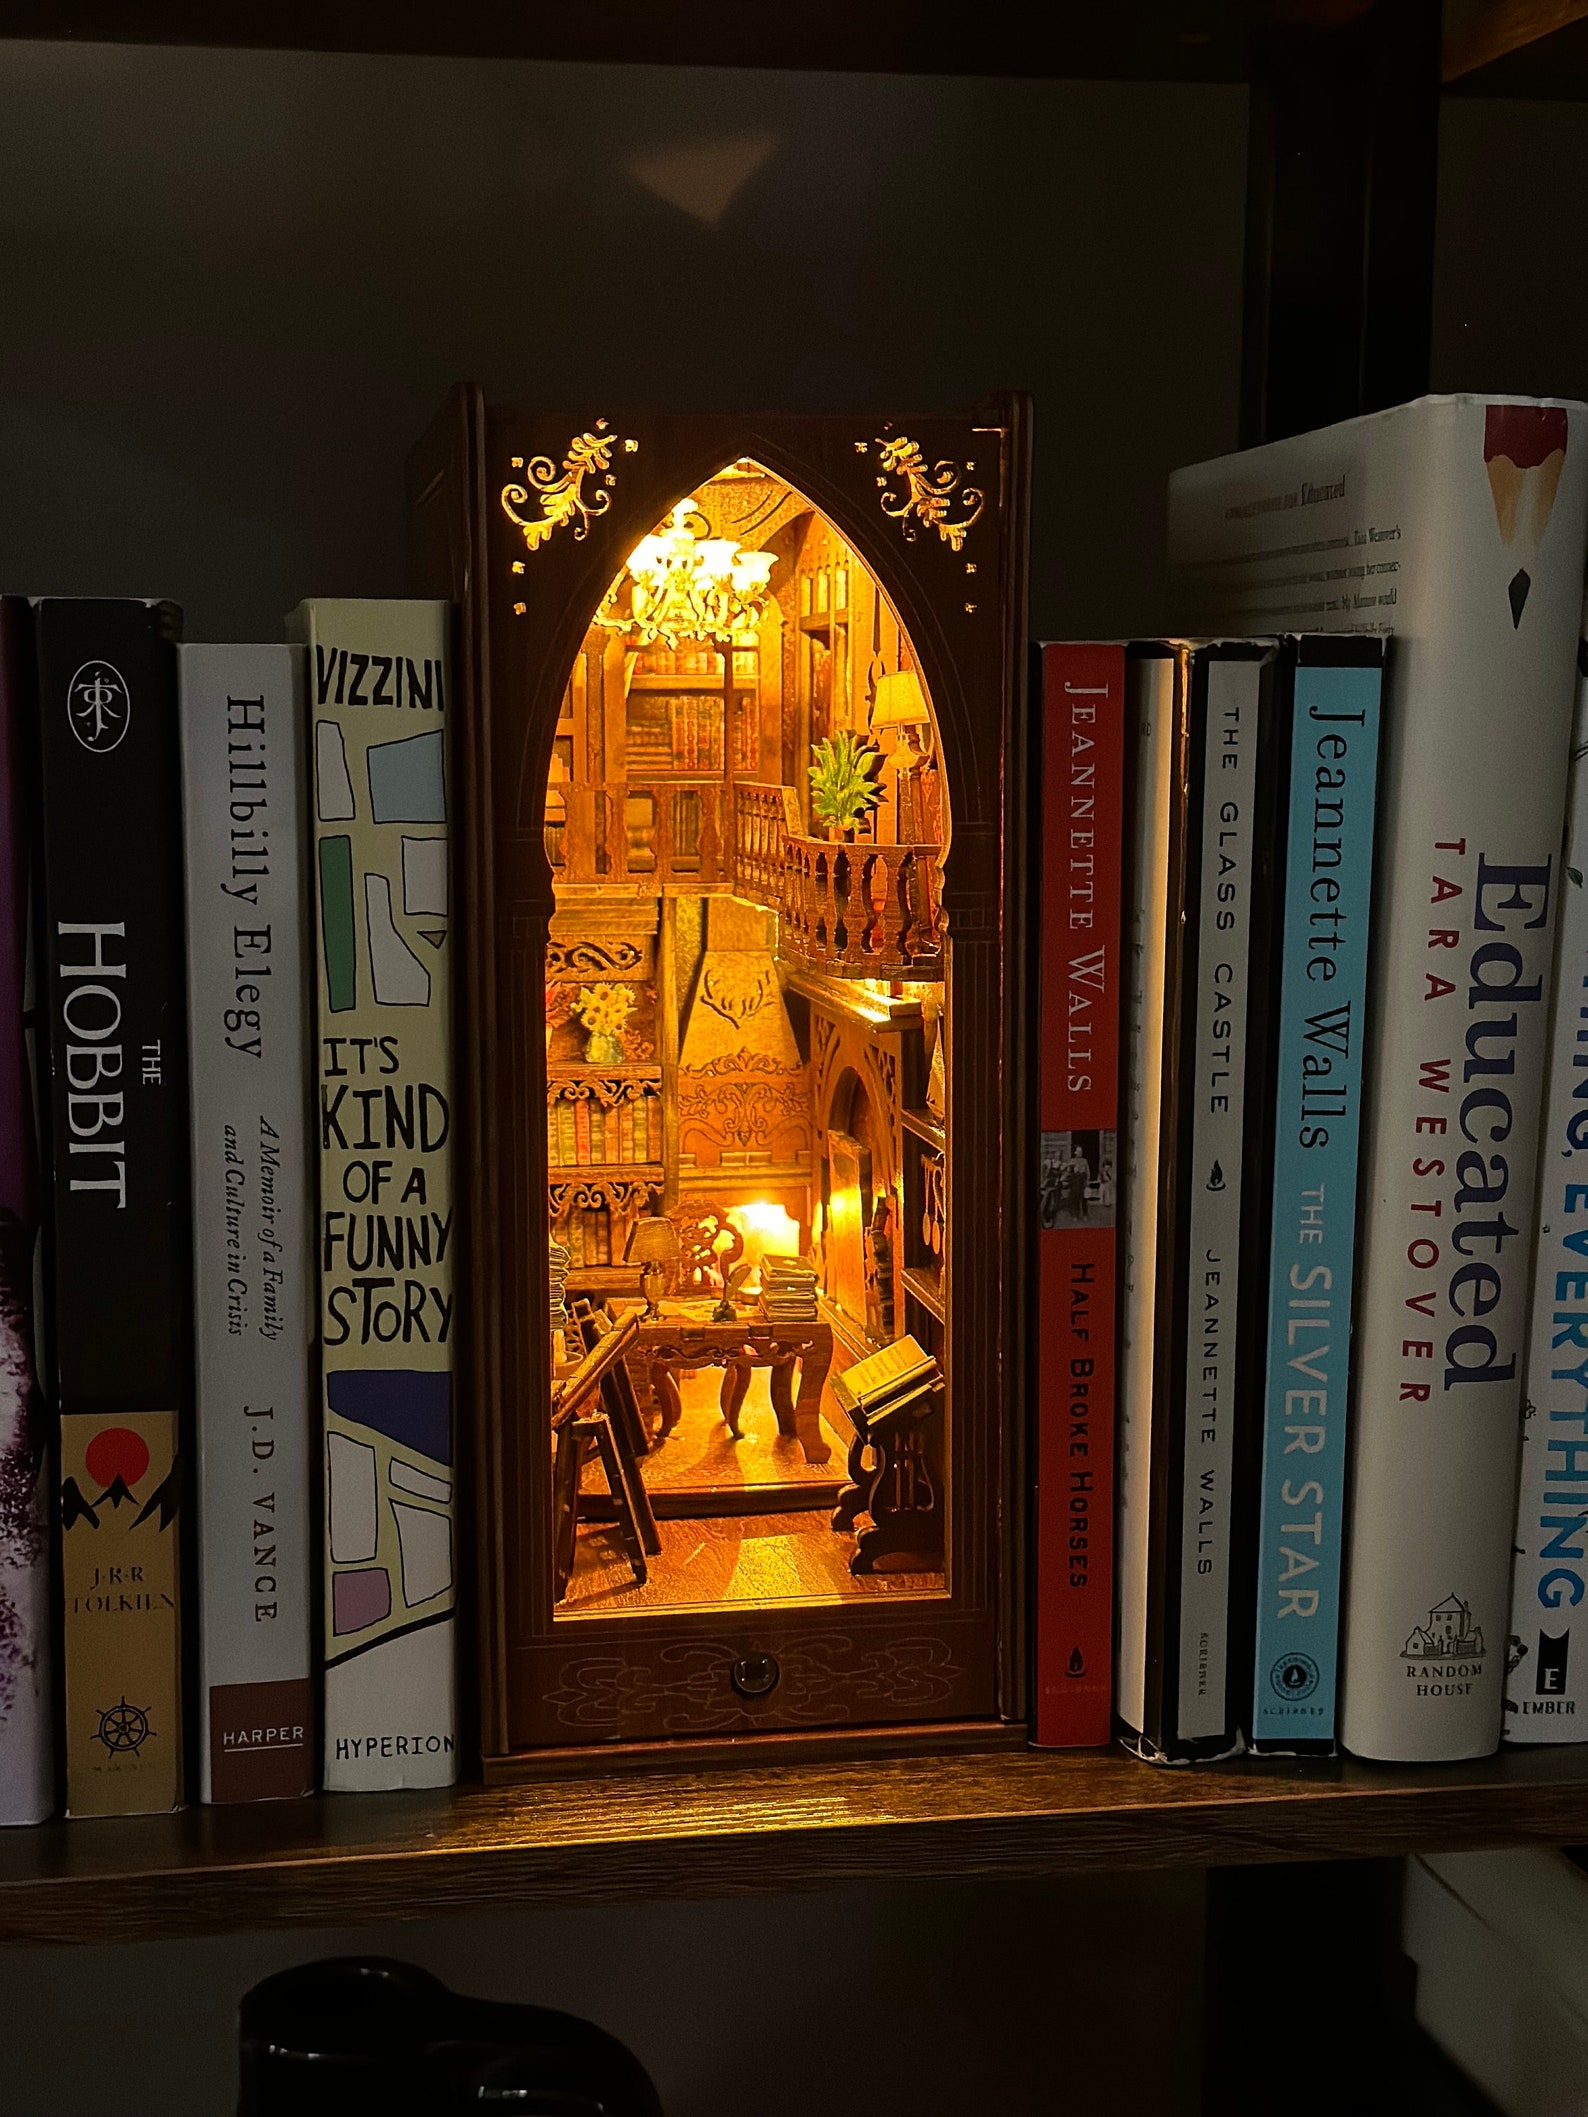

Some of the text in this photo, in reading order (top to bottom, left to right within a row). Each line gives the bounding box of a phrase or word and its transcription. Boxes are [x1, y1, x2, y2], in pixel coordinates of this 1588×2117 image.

[316, 645, 444, 711] VIZZINI
[220, 694, 272, 1059] Hillbilly Elegy
[1064, 681, 1109, 1092] JEANNETTE WALLS
[1210, 707, 1240, 1113] THE GLASS CASTLE
[1299, 704, 1366, 1149] Jeannette Walls
[58, 921, 126, 1209] HOBBIT
[141, 1039, 162, 1085] THE
[323, 1036, 399, 1077] IT'S
[321, 1083, 450, 1153] KIND
[1399, 837, 1466, 1402] TARA WESTOVER
[1443, 852, 1552, 1391] Educated
[224, 1124, 248, 1336] and Culture in Crisis
[257, 1115, 284, 1341] A Memoir of a Family
[343, 1160, 427, 1205] OF A
[1299, 1183, 1325, 1244] THE
[323, 1206, 453, 1272] FUNNY
[323, 1276, 453, 1346] STORY
[1283, 1263, 1333, 1455] SILVER
[1068, 1263, 1095, 1588] HALF BROKE HORSES
[1197, 1249, 1221, 1575] JEANNETTE WALLS
[252, 1492, 278, 1623] VANCE
[1276, 1479, 1324, 1620] STAR
[1406, 1664, 1483, 1679] RANDOM
[1416, 1683, 1474, 1697] HOUSE
[1522, 1701, 1576, 1715] EMBER
[1544, 1668, 1561, 1690] E
[223, 1725, 304, 1746] HARPER
[335, 1733, 456, 1760] HYPERION
